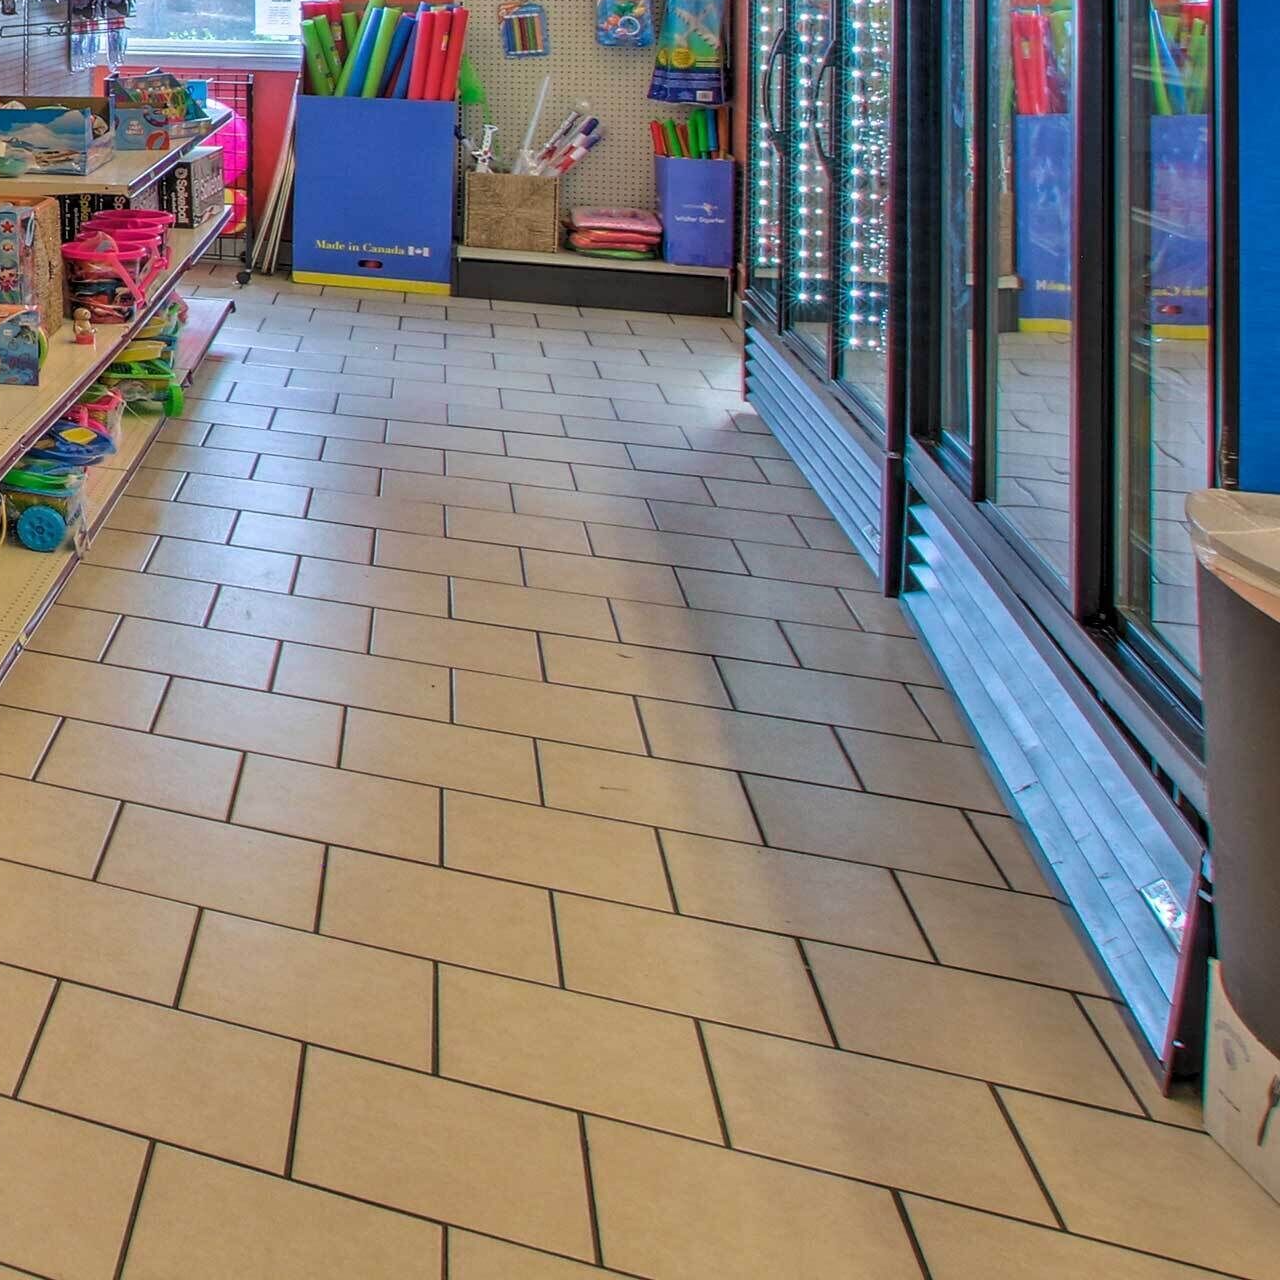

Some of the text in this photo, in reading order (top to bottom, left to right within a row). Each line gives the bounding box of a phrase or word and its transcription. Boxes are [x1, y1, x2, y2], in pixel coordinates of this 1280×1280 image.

[315, 239, 405, 255] Made in Canada
